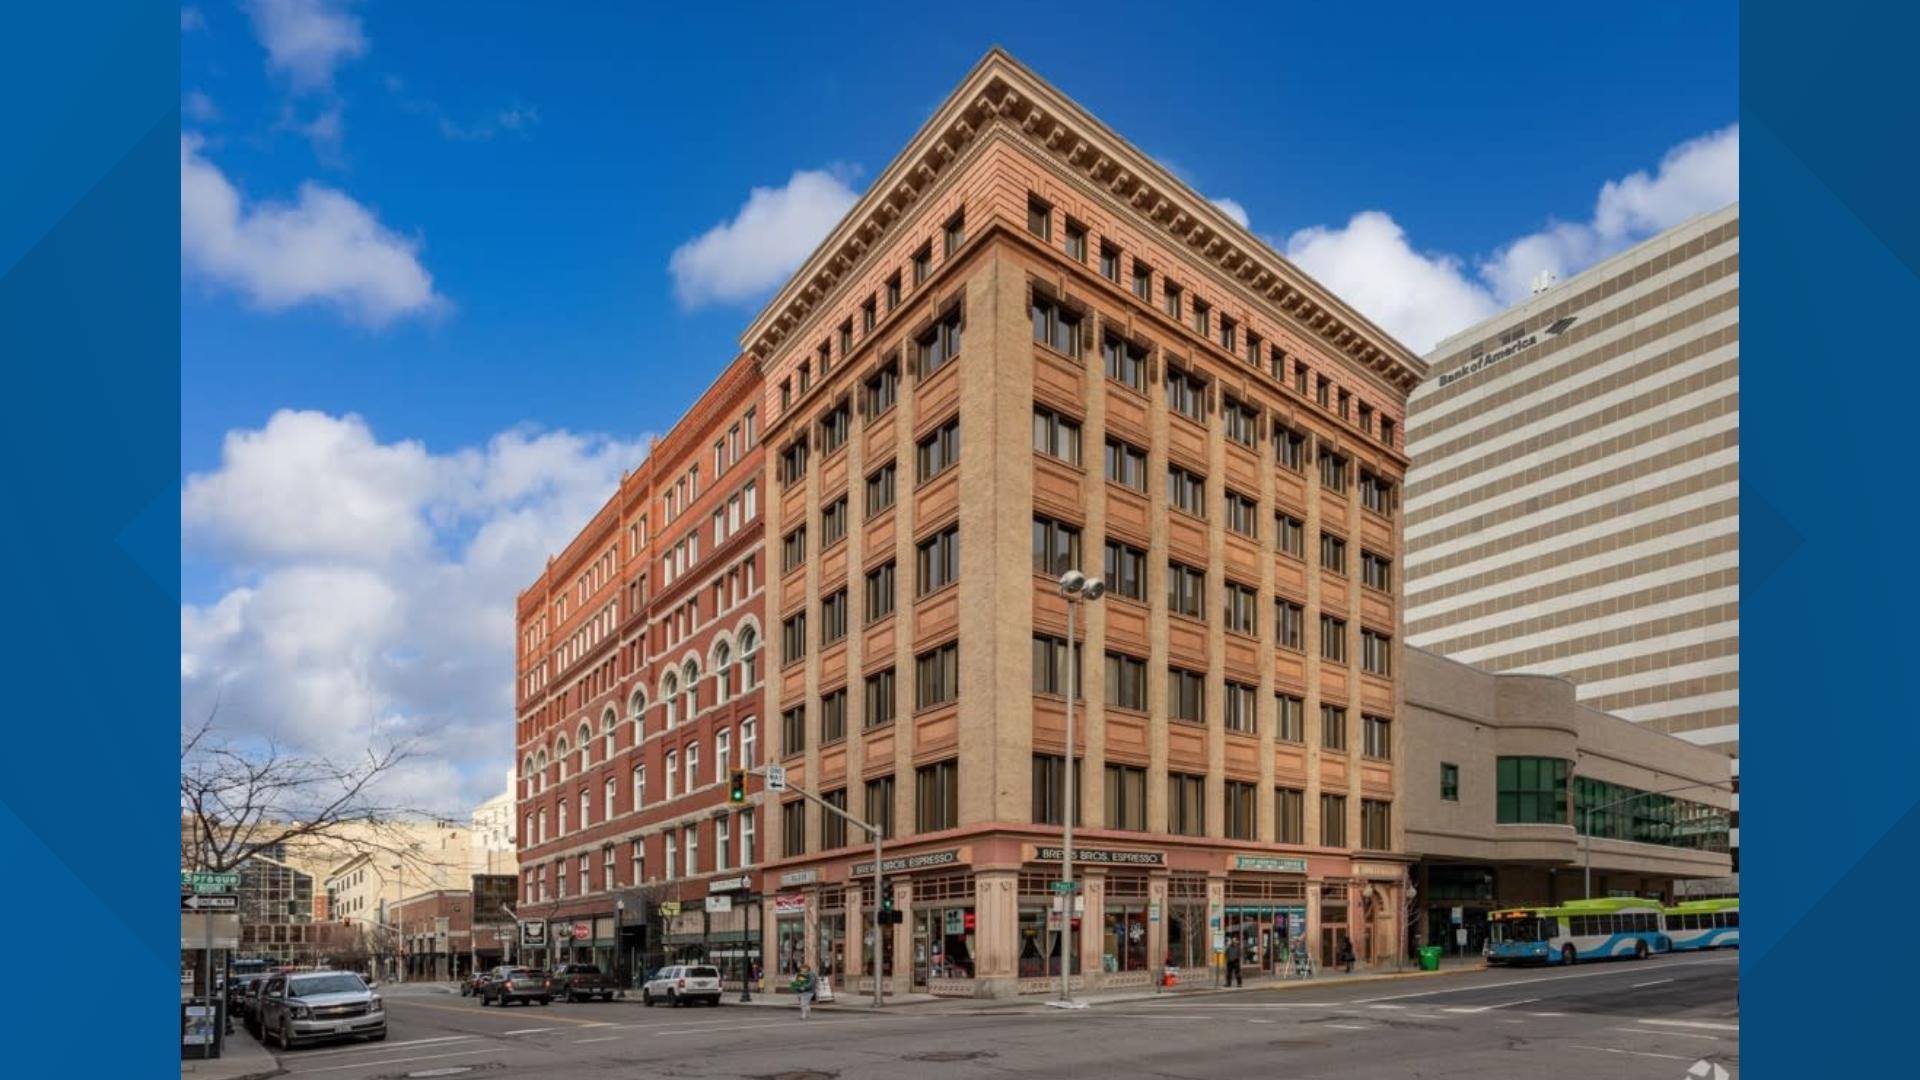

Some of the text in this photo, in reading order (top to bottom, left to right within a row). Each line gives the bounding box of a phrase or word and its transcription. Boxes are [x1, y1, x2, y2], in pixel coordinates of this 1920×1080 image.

[1439, 336, 1537, 387] Bank of America
[856, 862, 880, 874] BREW
[909, 853, 953, 867] ESPRESSO
[1111, 853, 1159, 864] ESPRESSO
[183, 874, 237, 885] Sprague
